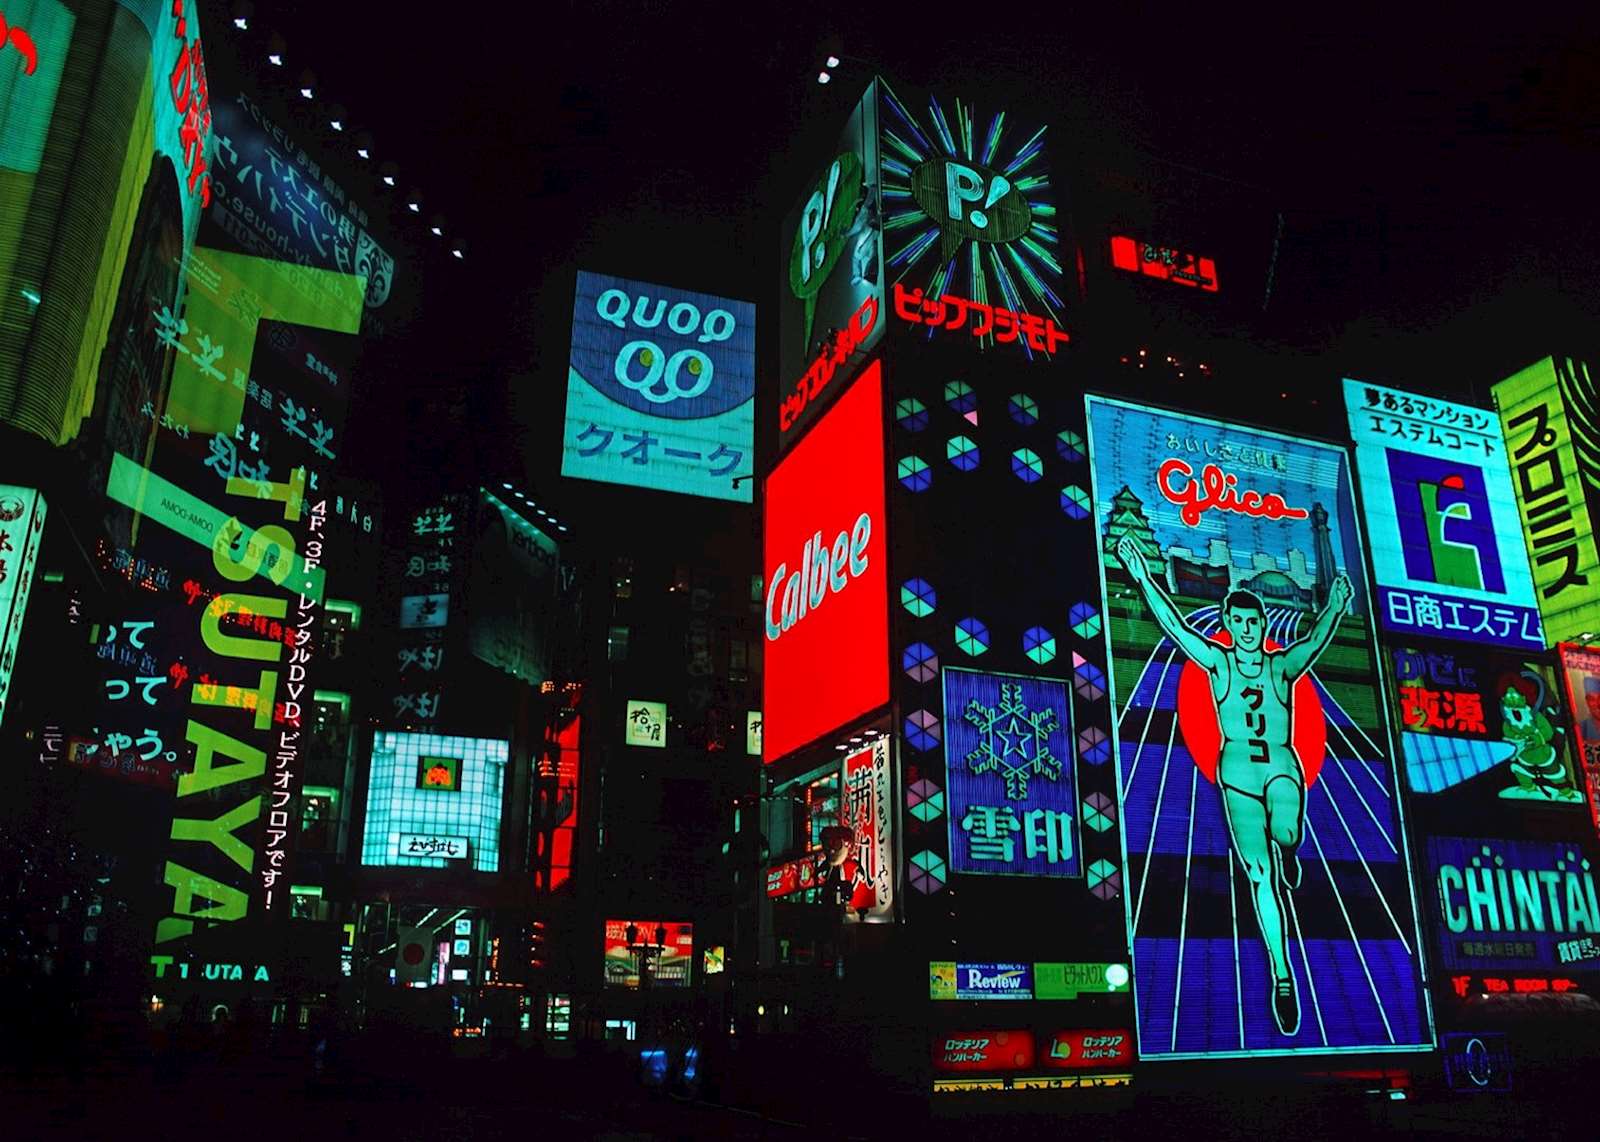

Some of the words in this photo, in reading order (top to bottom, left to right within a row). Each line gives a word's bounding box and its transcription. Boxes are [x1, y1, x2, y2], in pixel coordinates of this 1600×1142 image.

[893, 283, 1069, 353] ピップフジモト
[1363, 386, 1490, 430] 夢あるマンション
[1369, 415, 1495, 457] エステムコート
[576, 422, 744, 477] クオーク
[1507, 403, 1588, 599] プロミス
[766, 512, 872, 641] Calbee
[155, 467, 307, 945] TSUTAYA
[1240, 684, 1270, 764] グリコ
[961, 805, 1074, 864] 雪印
[968, 969, 1021, 989] Review
[945, 1038, 990, 1050] ロッテリア
[1083, 1036, 1123, 1047] ロッテリア
